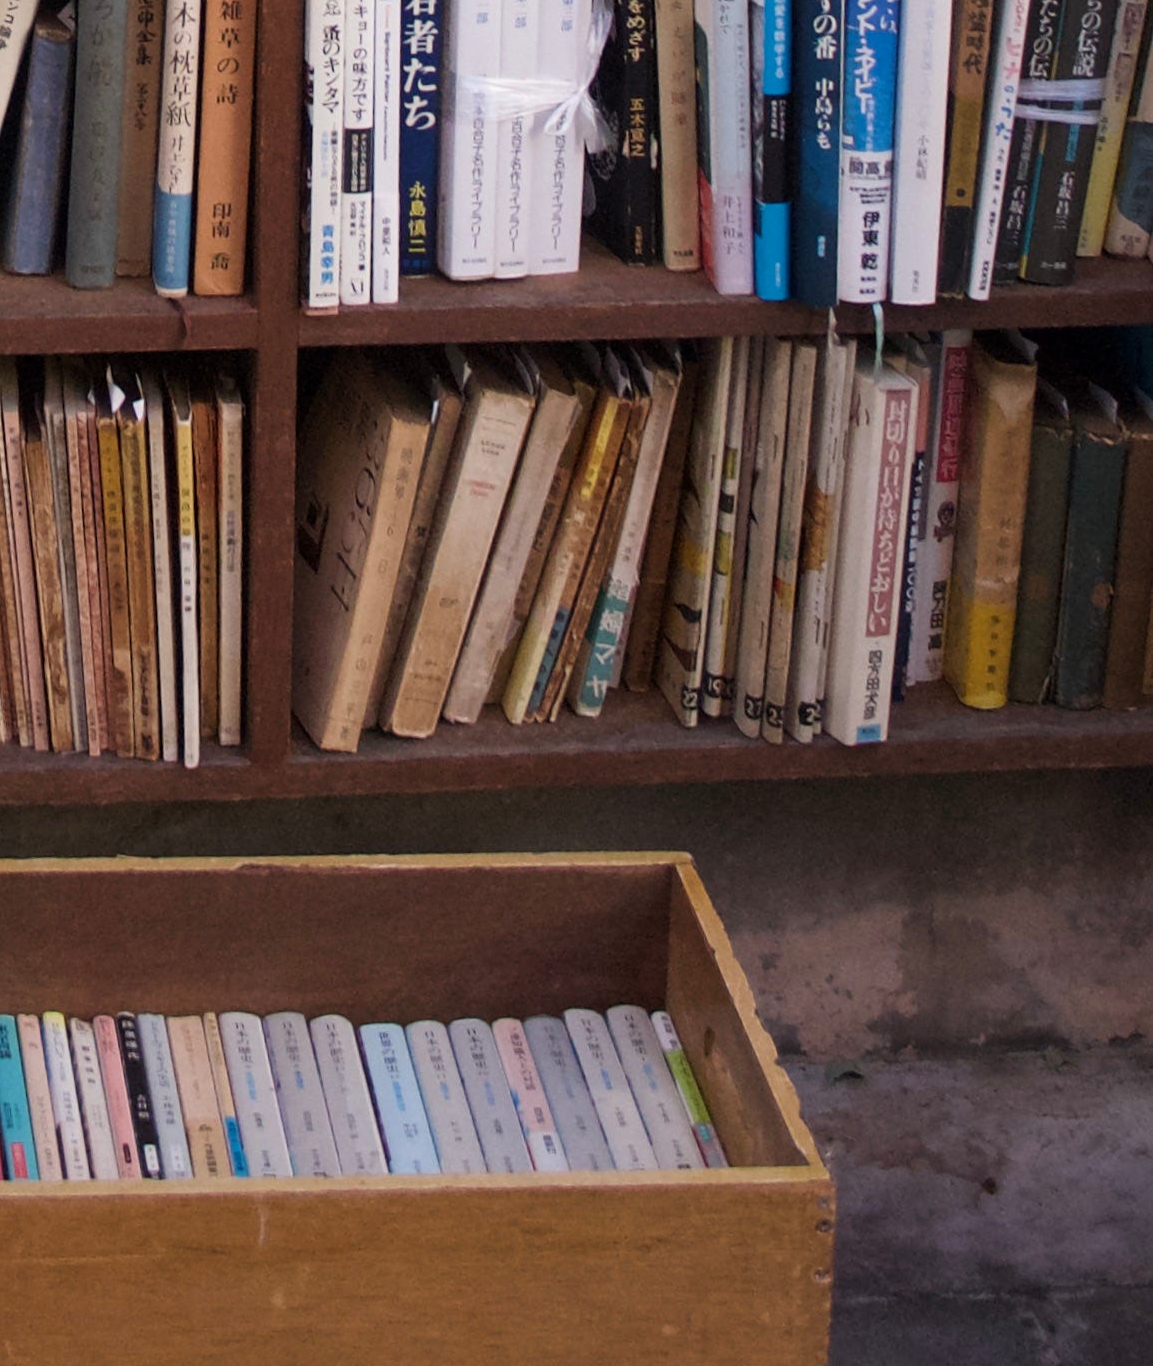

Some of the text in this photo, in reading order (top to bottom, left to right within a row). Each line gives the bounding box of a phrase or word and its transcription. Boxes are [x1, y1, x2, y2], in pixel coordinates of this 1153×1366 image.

[166, 0, 196, 127] 本の枕草紙
[216, 0, 244, 106] 雑草の詩
[814, 77, 835, 151] 中島らも
[407, 181, 426, 253] 永島慎二
